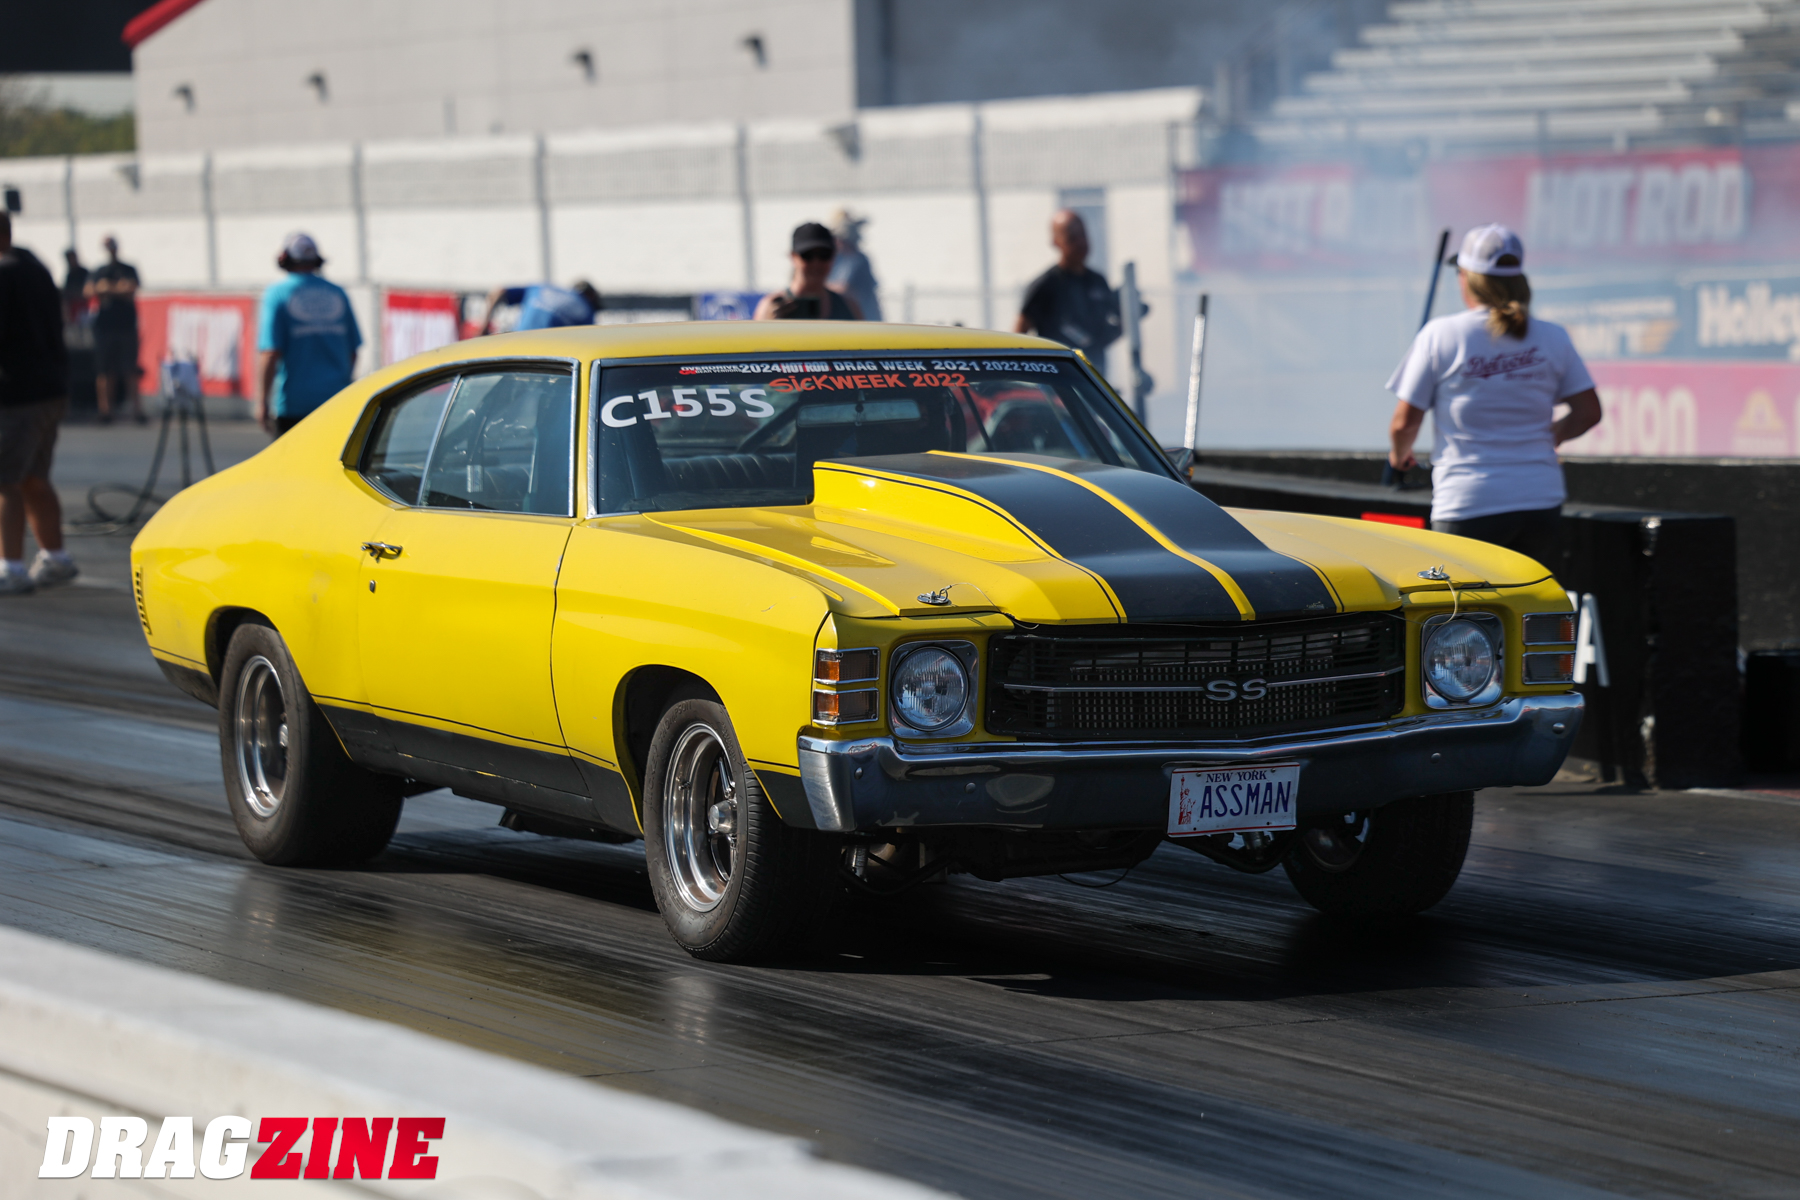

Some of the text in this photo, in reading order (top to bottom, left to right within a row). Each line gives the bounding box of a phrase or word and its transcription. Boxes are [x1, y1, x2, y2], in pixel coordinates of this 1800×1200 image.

[1636, 160, 1745, 246] ROD
[739, 363, 781, 373] 2024
[833, 361, 878, 371] DRAG
[880, 360, 927, 371] WEEK
[931, 360, 980, 371] 2021
[982, 361, 1021, 371] 2022
[1021, 361, 1058, 374] 2023
[909, 373, 969, 387] 2022
[601, 388, 775, 428] C155S
[1206, 678, 1267, 701] SS
[1206, 770, 1267, 783] NEW YORK
[1200, 781, 1291, 819] ASSMAN
